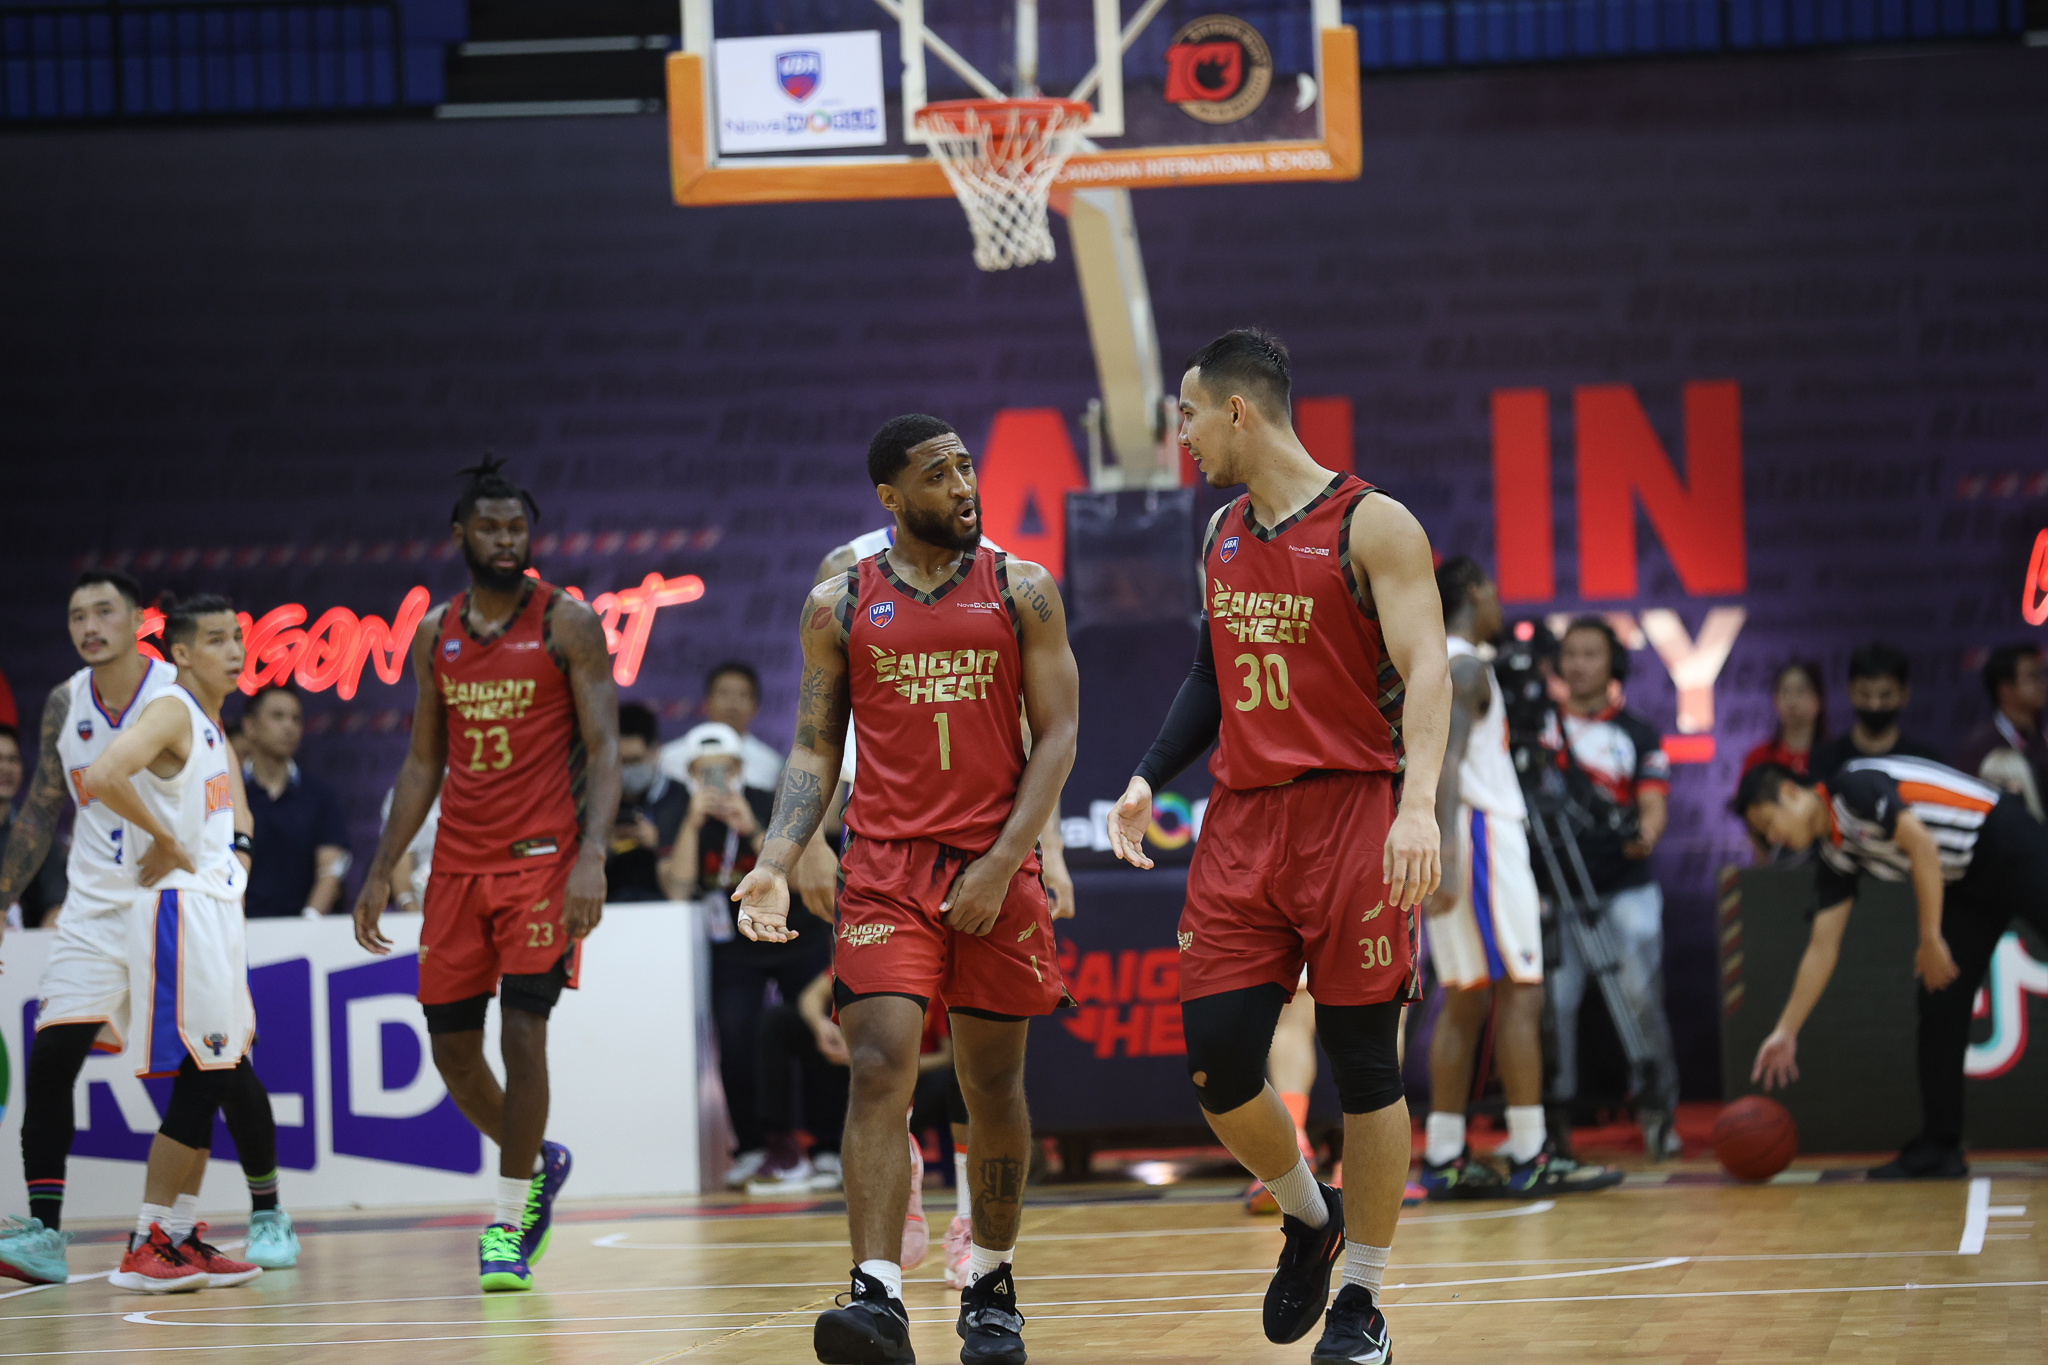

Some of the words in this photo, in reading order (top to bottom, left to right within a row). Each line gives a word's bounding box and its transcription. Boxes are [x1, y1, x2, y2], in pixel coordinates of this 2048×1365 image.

[1266, 148, 1333, 172] SCHOOL
[1490, 379, 1748, 605] IN
[872, 604, 892, 616] VBA
[1212, 590, 1314, 622] SAIGON
[1225, 617, 1310, 644] HEAT
[873, 648, 999, 684] SAIGON
[444, 679, 537, 705] SAIGON
[893, 674, 994, 705] HEAT
[1234, 653, 1290, 712] 30
[463, 725, 513, 772] 23
[932, 712, 951, 771] 1
[526, 922, 554, 948] 23
[1358, 935, 1393, 970] 30
[1029, 955, 1043, 983] 1
